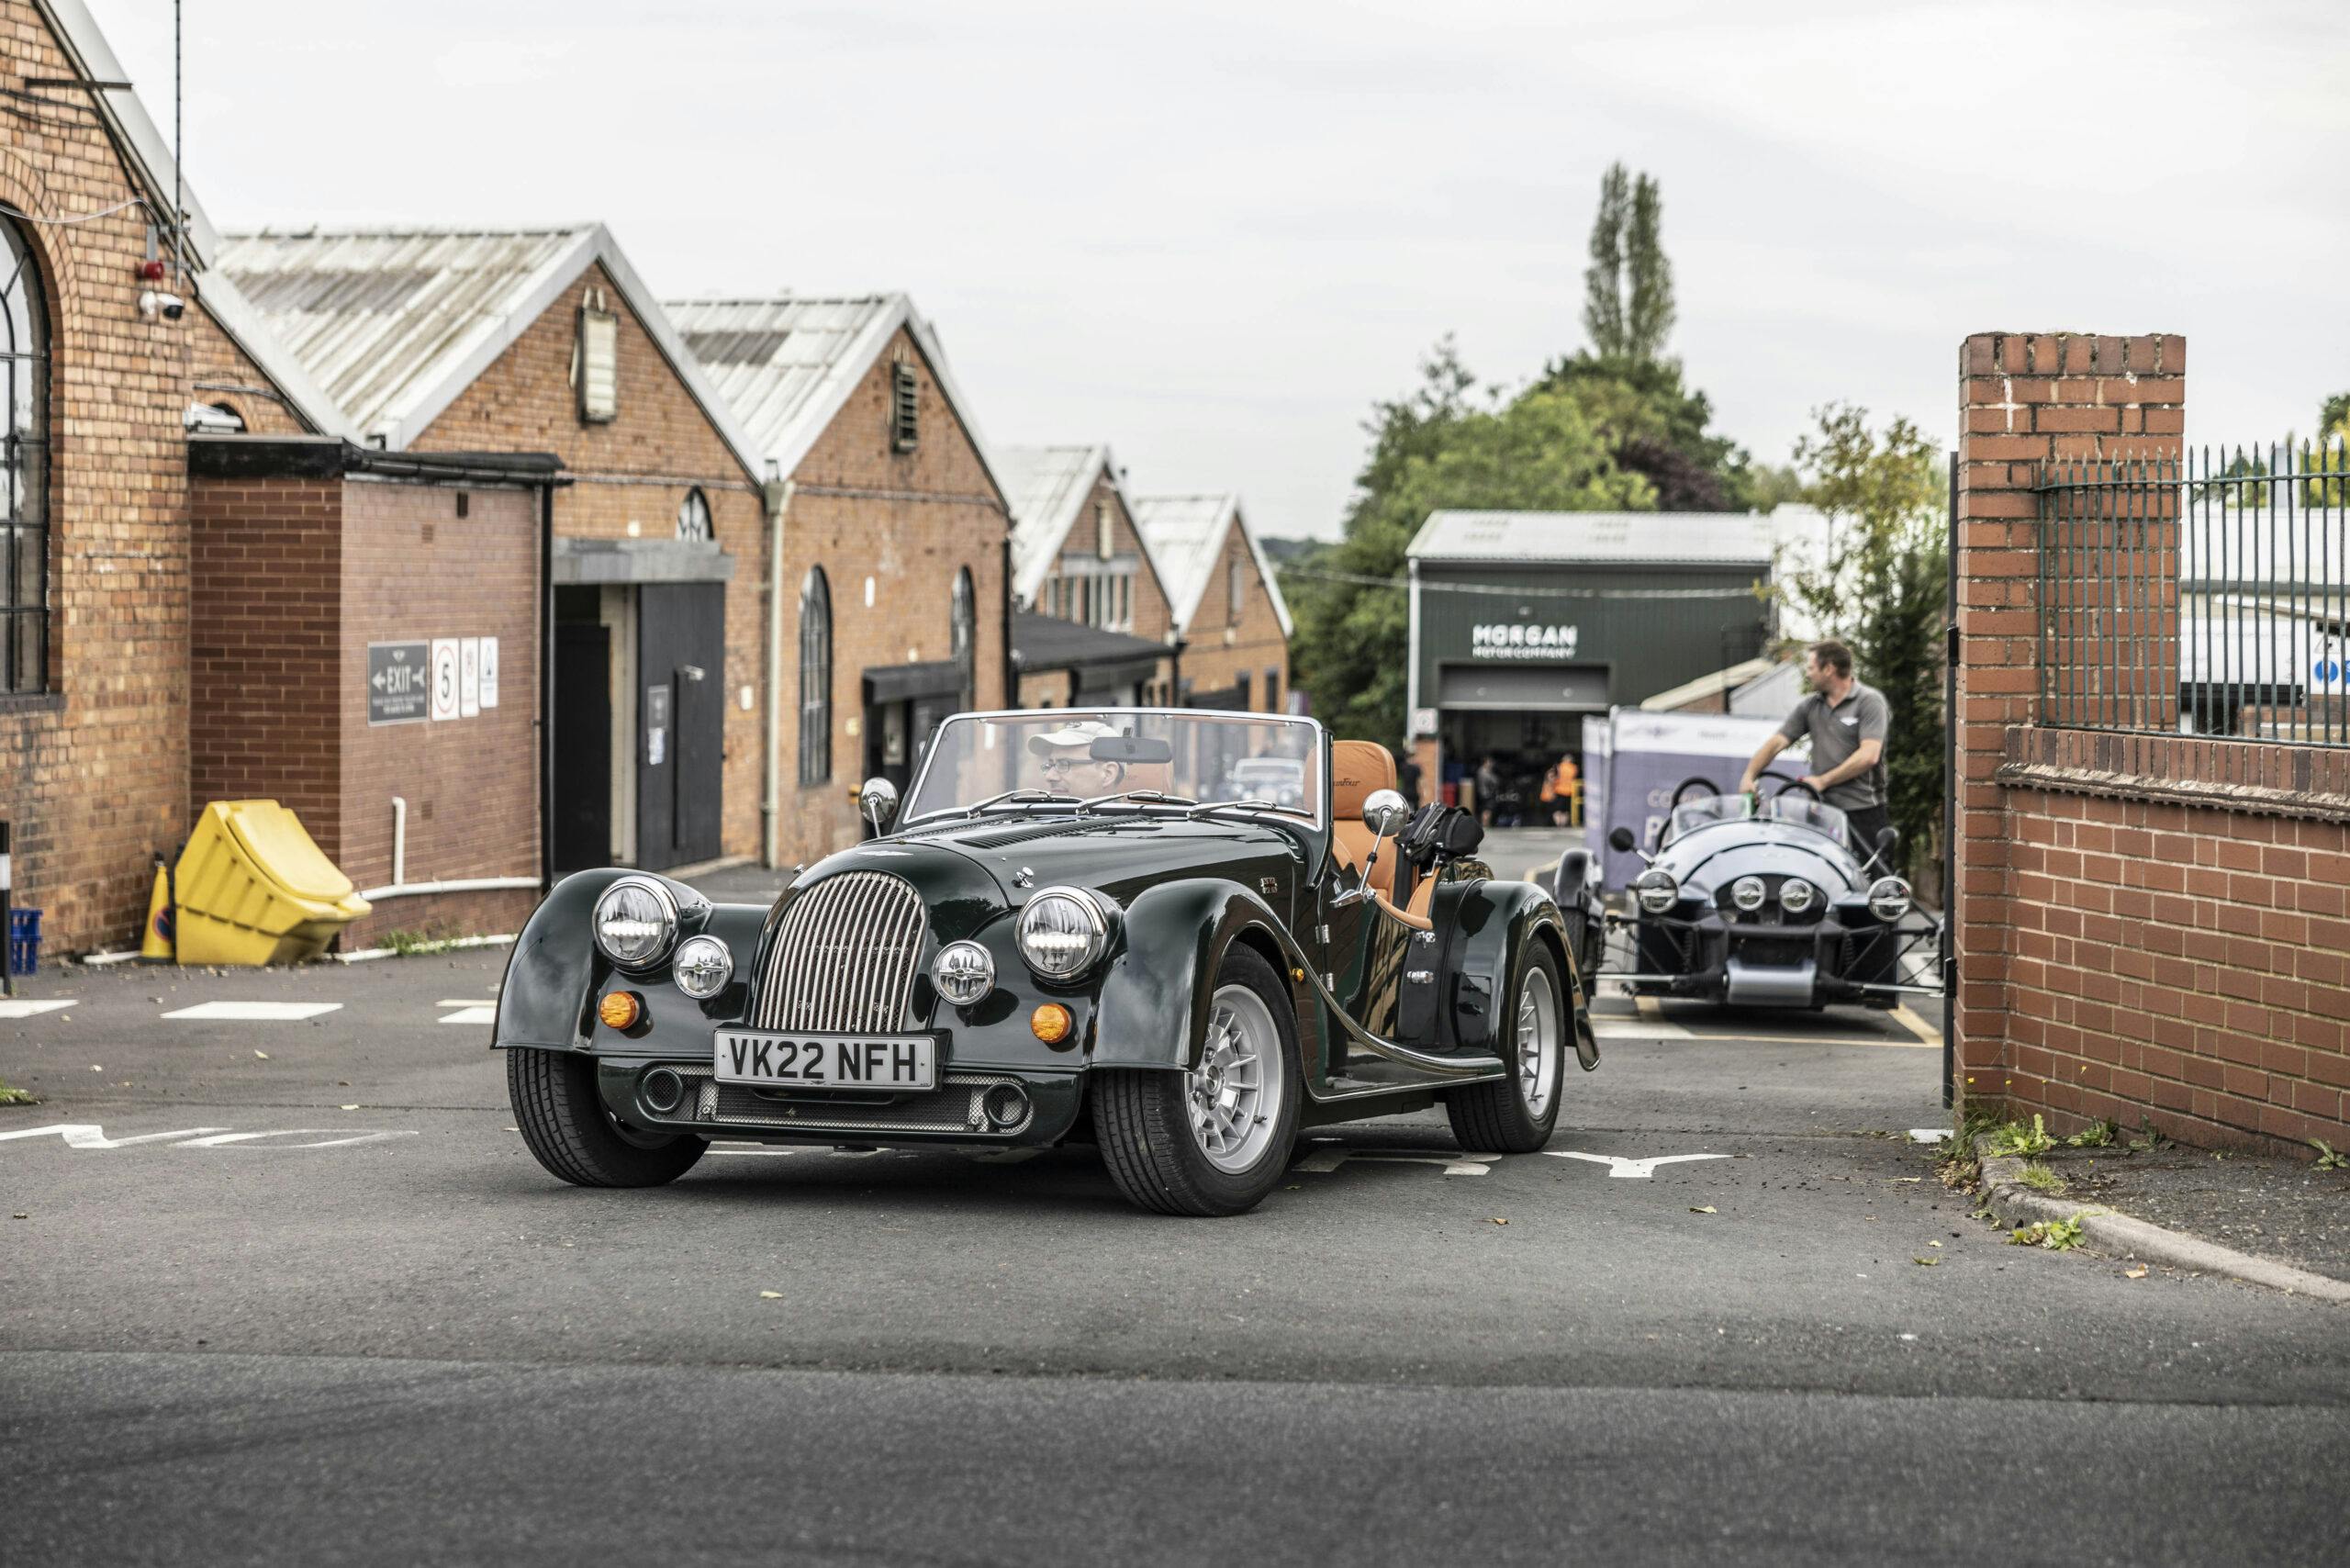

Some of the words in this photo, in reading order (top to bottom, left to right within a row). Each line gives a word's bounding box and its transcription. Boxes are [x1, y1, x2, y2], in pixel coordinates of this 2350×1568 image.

[1472, 624, 1578, 646] MORGAN
[386, 665, 411, 694] EXIT
[441, 663, 450, 699] 5
[729, 1037, 824, 1080] VK22
[837, 1042, 916, 1081] NFH
